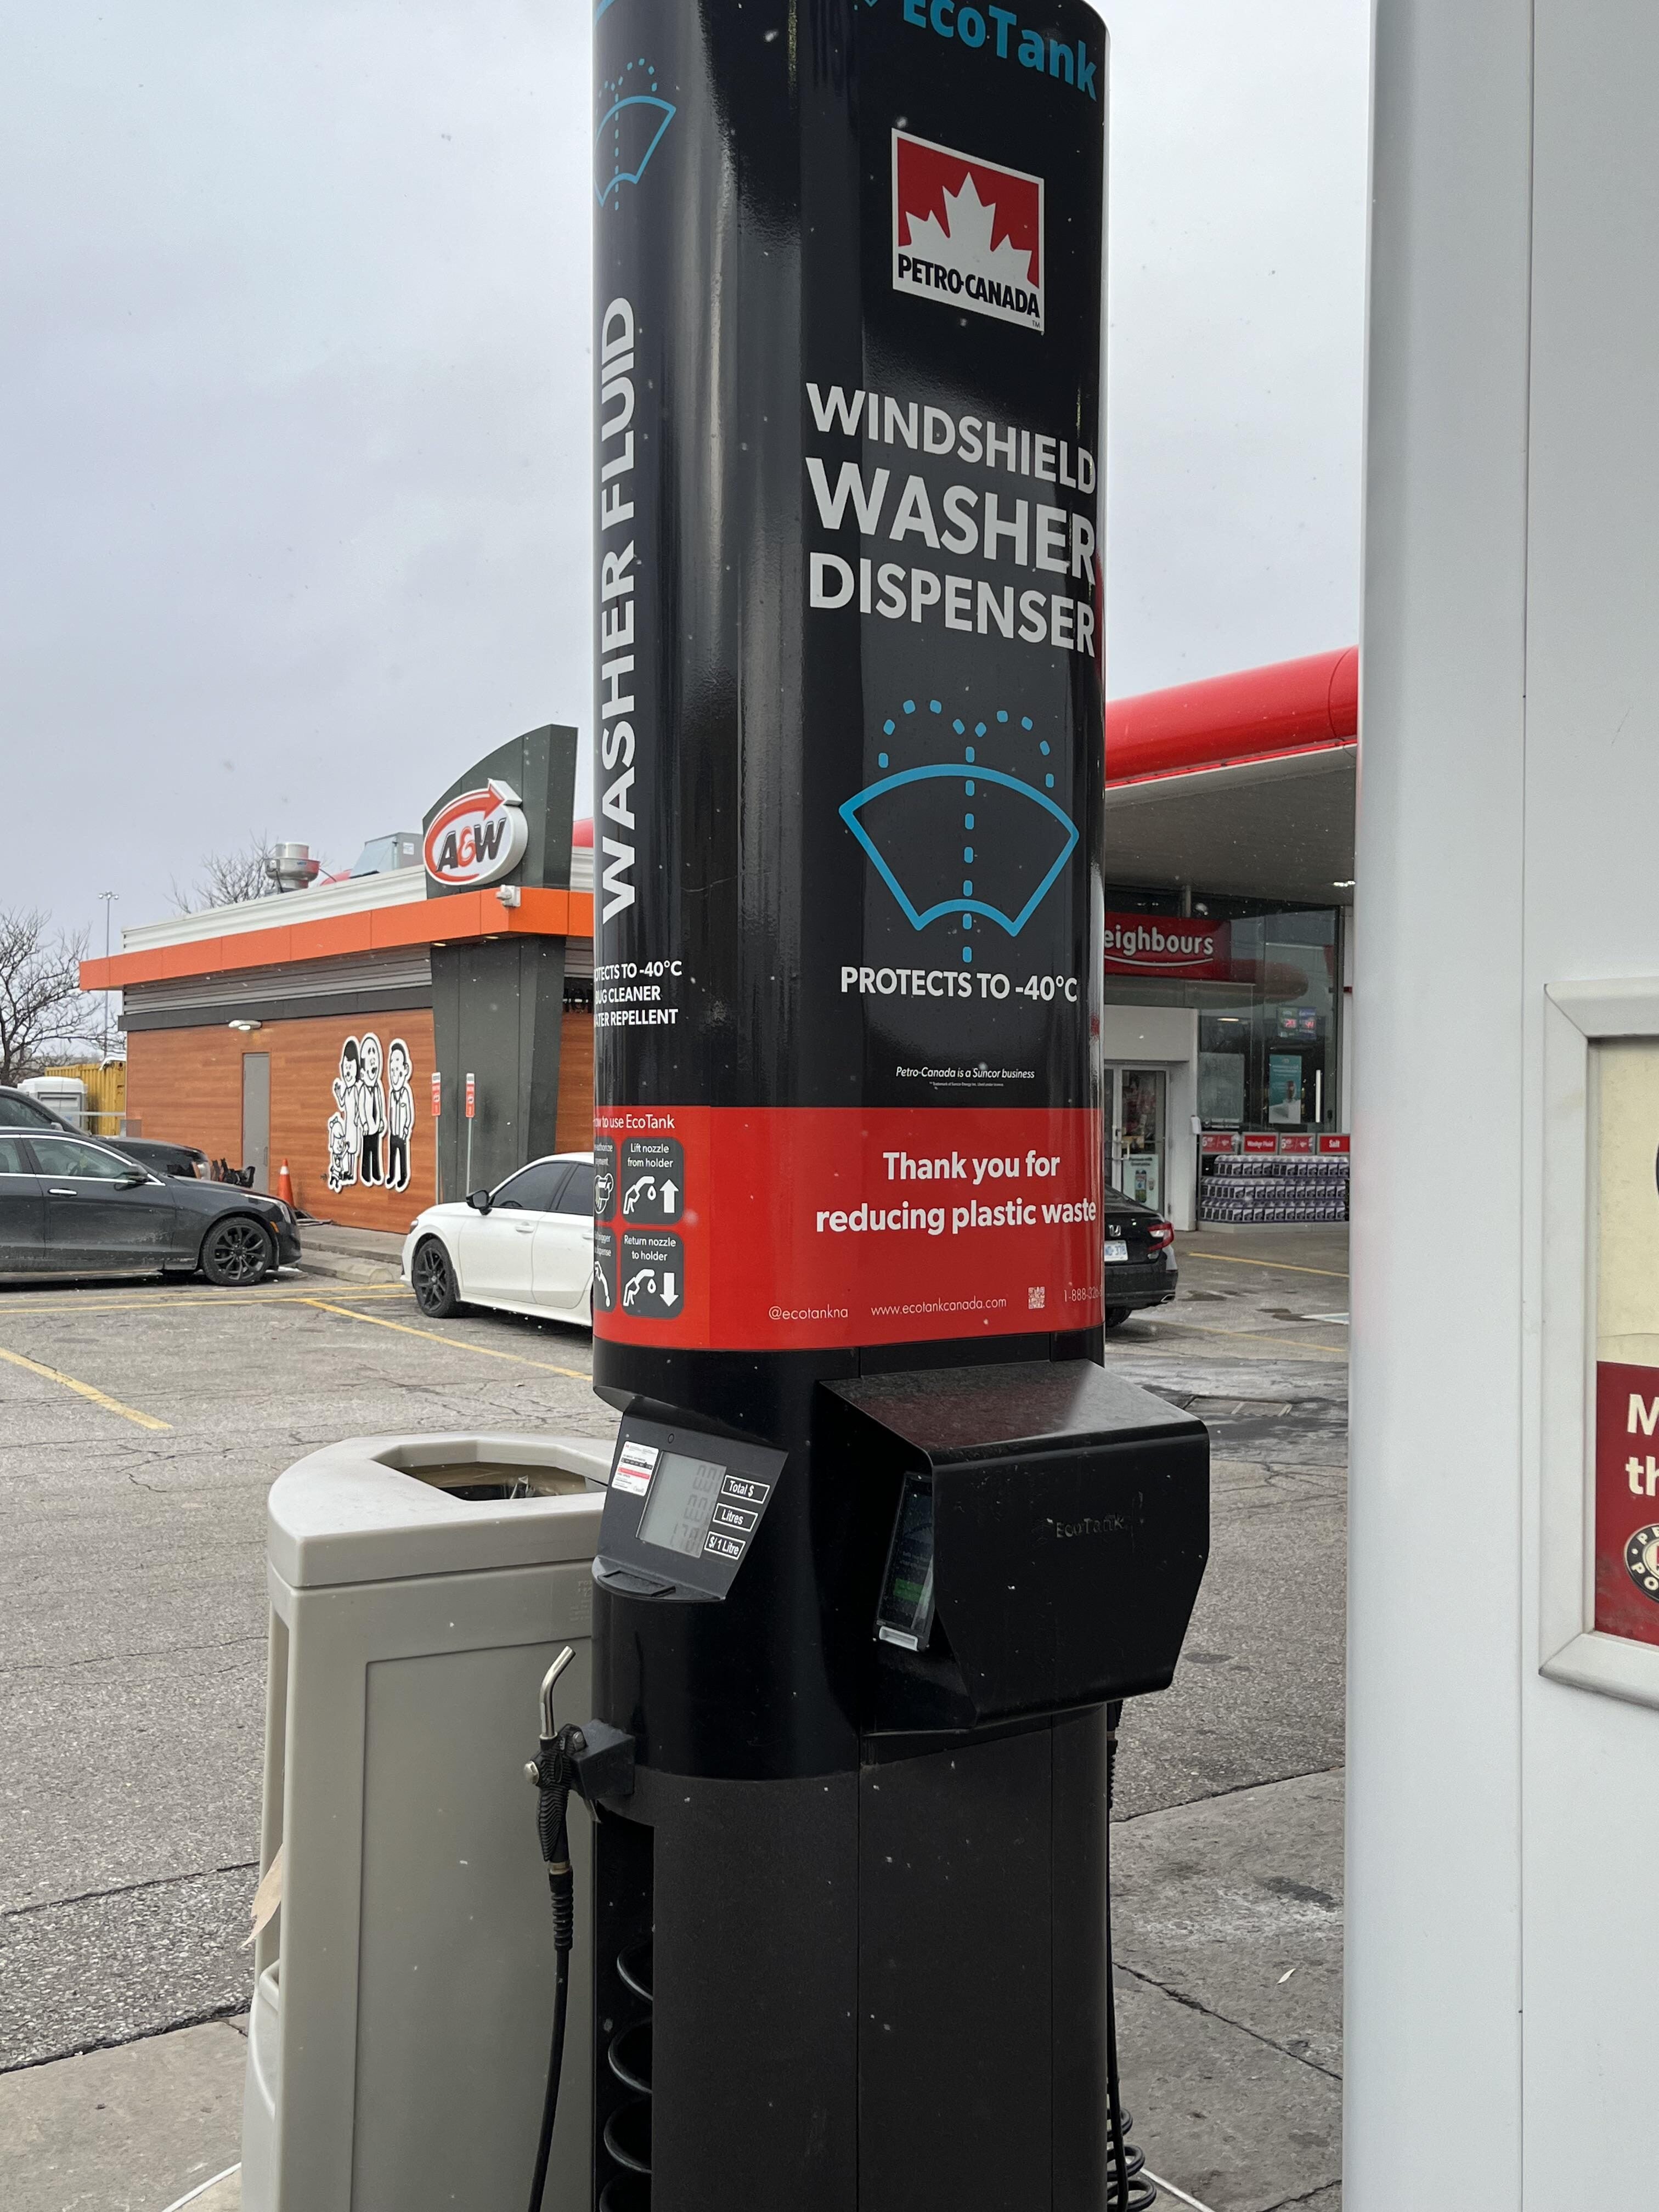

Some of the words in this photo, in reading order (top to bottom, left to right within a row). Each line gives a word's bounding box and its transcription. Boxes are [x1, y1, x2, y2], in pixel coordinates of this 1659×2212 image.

[903, 0, 1097, 101] EcoTank
[898, 253, 1040, 318] PETRO-CANADA
[601, 297, 635, 531] FLUID
[806, 382, 1096, 494] WINDSHIELD
[805, 456, 1096, 586] WASHER
[810, 552, 1095, 658] DISPENSER
[601, 540, 635, 925] WASHER
[436, 817, 506, 872] A&W
[1104, 924, 1214, 956] eighbours
[622, 963, 637, 979] TO
[640, 960, 682, 977] -40°C
[841, 966, 972, 998] PROTECTS
[977, 973, 1010, 999] TO
[1015, 975, 1077, 1002] -40°C
[608, 985, 661, 1003] CLEANER
[595, 1011, 609, 1027] ATER
[611, 1008, 679, 1026] REPELLENT
[896, 1066, 955, 1077] Petro-Canada
[957, 1068, 964, 1077] is
[973, 1068, 1001, 1079] Suncor
[1002, 1069, 1035, 1079] business
[602, 1115, 609, 1128] to
[610, 1118, 624, 1128] use
[626, 1114, 675, 1128] EcoTank
[630, 1142, 641, 1153] Lift
[642, 1143, 669, 1153] nozzle
[1329, 1139, 1340, 1148] Salt
[628, 1156, 644, 1167] from
[645, 1158, 673, 1167] holder
[883, 1152, 967, 1180] Thank
[972, 1158, 1019, 1185] you
[1025, 1150, 1060, 1177] for
[816, 1201, 945, 1235] reducing
[952, 1197, 1036, 1234] plastic
[1042, 1198, 1096, 1224] waste
[624, 1234, 647, 1245] Return
[648, 1237, 676, 1247] nozzle
[632, 1250, 639, 1259] to
[641, 1250, 668, 1261] holder
[769, 1304, 848, 1321] @ecotankna
[871, 1295, 1007, 1316] www.ecotankcanada.com
[729, 1480, 748, 1495] Total
[748, 1485, 754, 1498] $
[721, 1509, 744, 1525] Litres
[722, 1540, 739, 1555] Litre
